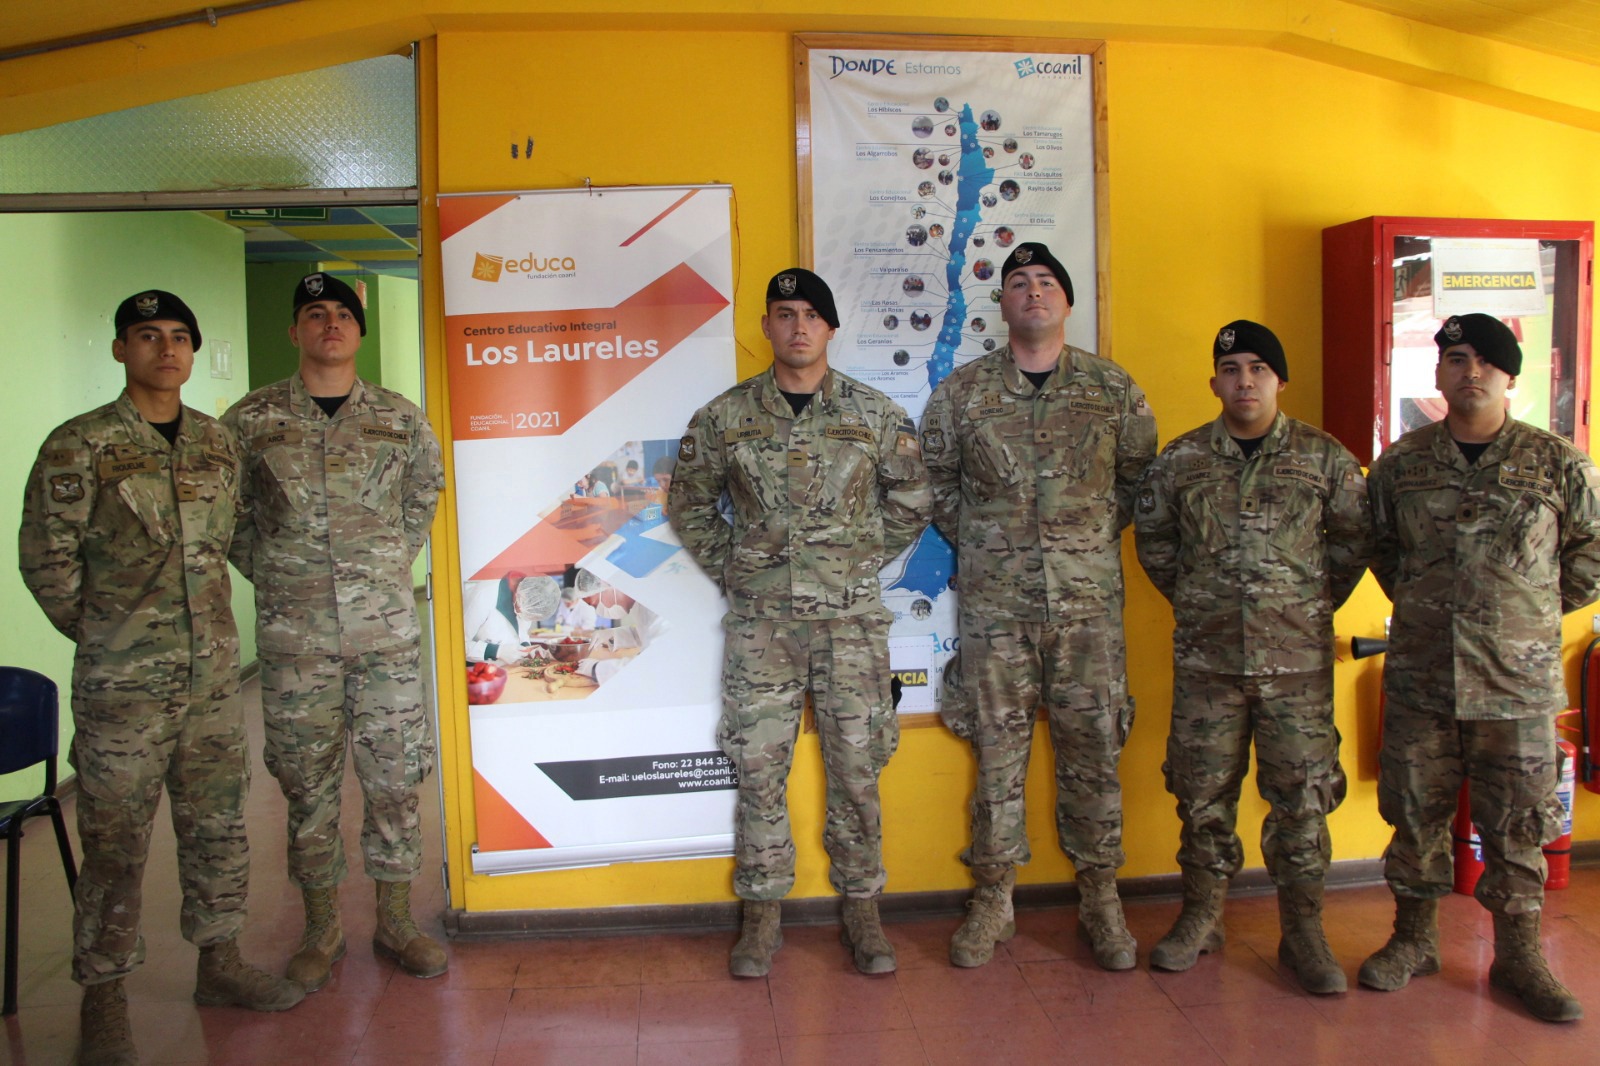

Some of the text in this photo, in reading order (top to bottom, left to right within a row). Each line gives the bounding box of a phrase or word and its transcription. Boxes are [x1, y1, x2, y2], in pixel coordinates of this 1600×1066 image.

[829, 55, 961, 79] DONDE Estamos
[1036, 56, 1081, 75] coanil
[505, 252, 576, 273] educa
[1443, 275, 1536, 288] EMERGENCIA
[464, 320, 616, 336] Centro Educativo Integral
[466, 336, 659, 366] Los Laureles
[980, 408, 1004, 416] MORENO
[516, 411, 560, 429] 2021
[737, 429, 762, 438] URRUTIA
[112, 462, 146, 472] RIQUELME
[652, 760, 678, 770] Fono:
[680, 759, 692, 768] 22
[695, 758, 714, 766] 844
[600, 774, 630, 784] E-mail:
